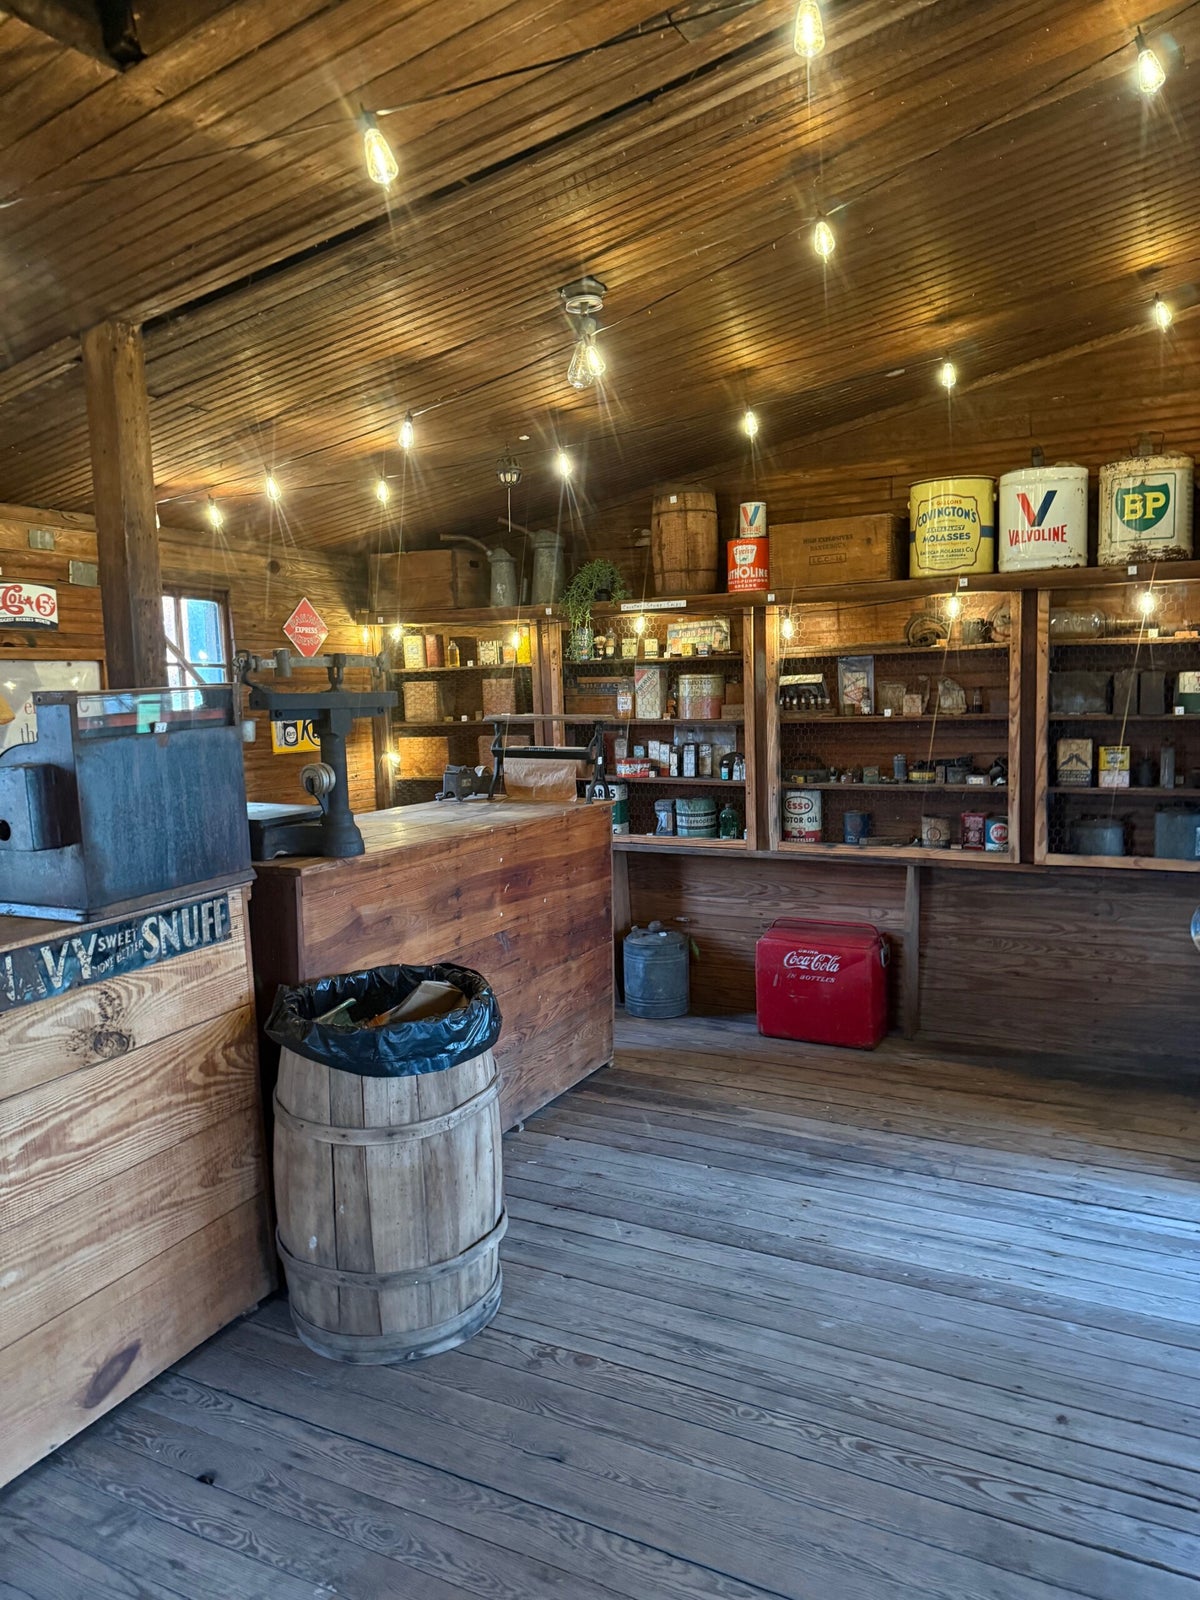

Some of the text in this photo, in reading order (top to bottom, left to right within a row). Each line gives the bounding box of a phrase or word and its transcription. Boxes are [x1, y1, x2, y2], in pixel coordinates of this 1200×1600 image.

[1122, 491, 1166, 520] BP
[917, 506, 977, 528] COVINGTON'S
[922, 532, 971, 544] MOLASSES
[1008, 524, 1068, 547] VALVOLINE
[294, 626, 318, 634] EXPRESS
[806, 815, 818, 824] OIL
[98, 928, 138, 952] SWEET
[141, 898, 227, 960] SNUFF
[783, 950, 842, 972] Coca-Cola
[799, 974, 837, 983] BOTTLES
